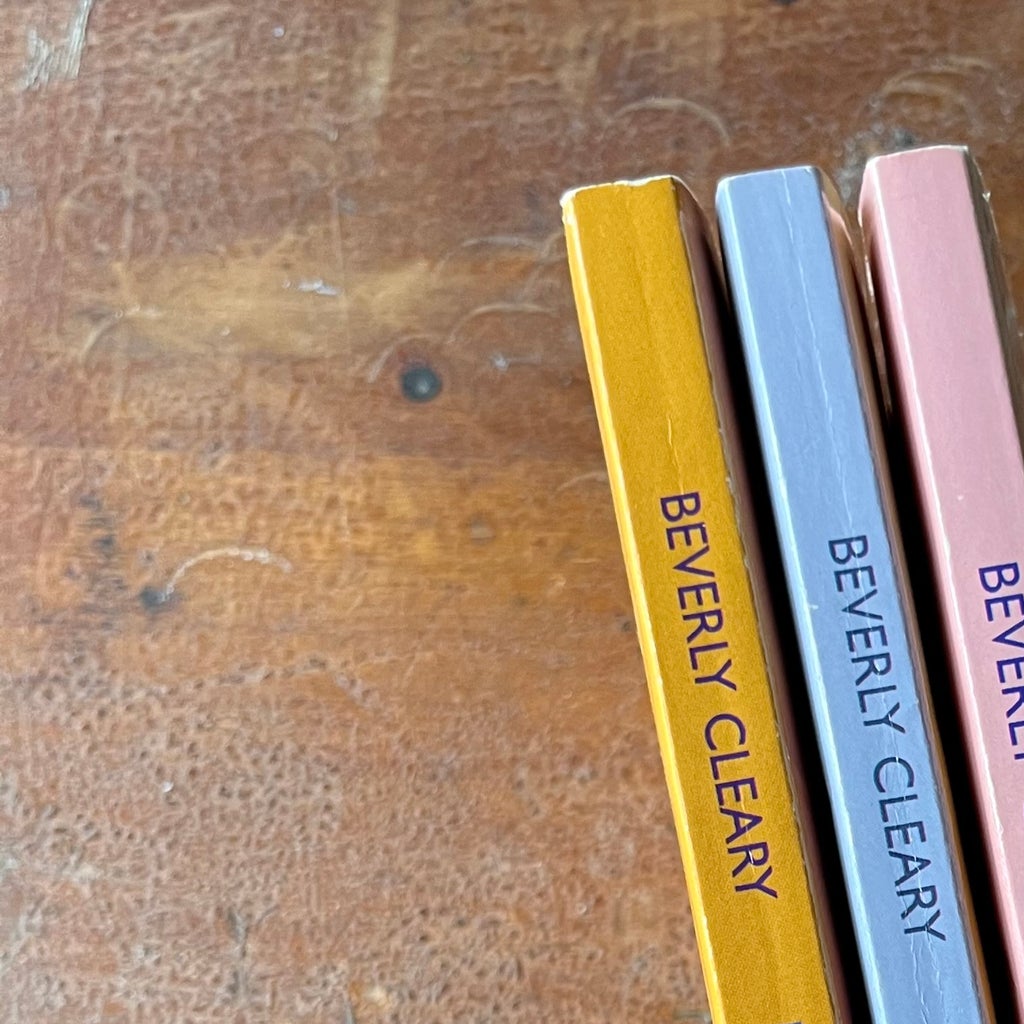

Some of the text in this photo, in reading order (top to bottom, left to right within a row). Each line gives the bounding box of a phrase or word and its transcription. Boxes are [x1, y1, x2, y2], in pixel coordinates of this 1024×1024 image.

[660, 490, 779, 900] BEVERLY CLEARY
[828, 534, 947, 942] BEVERLY CLEARY
